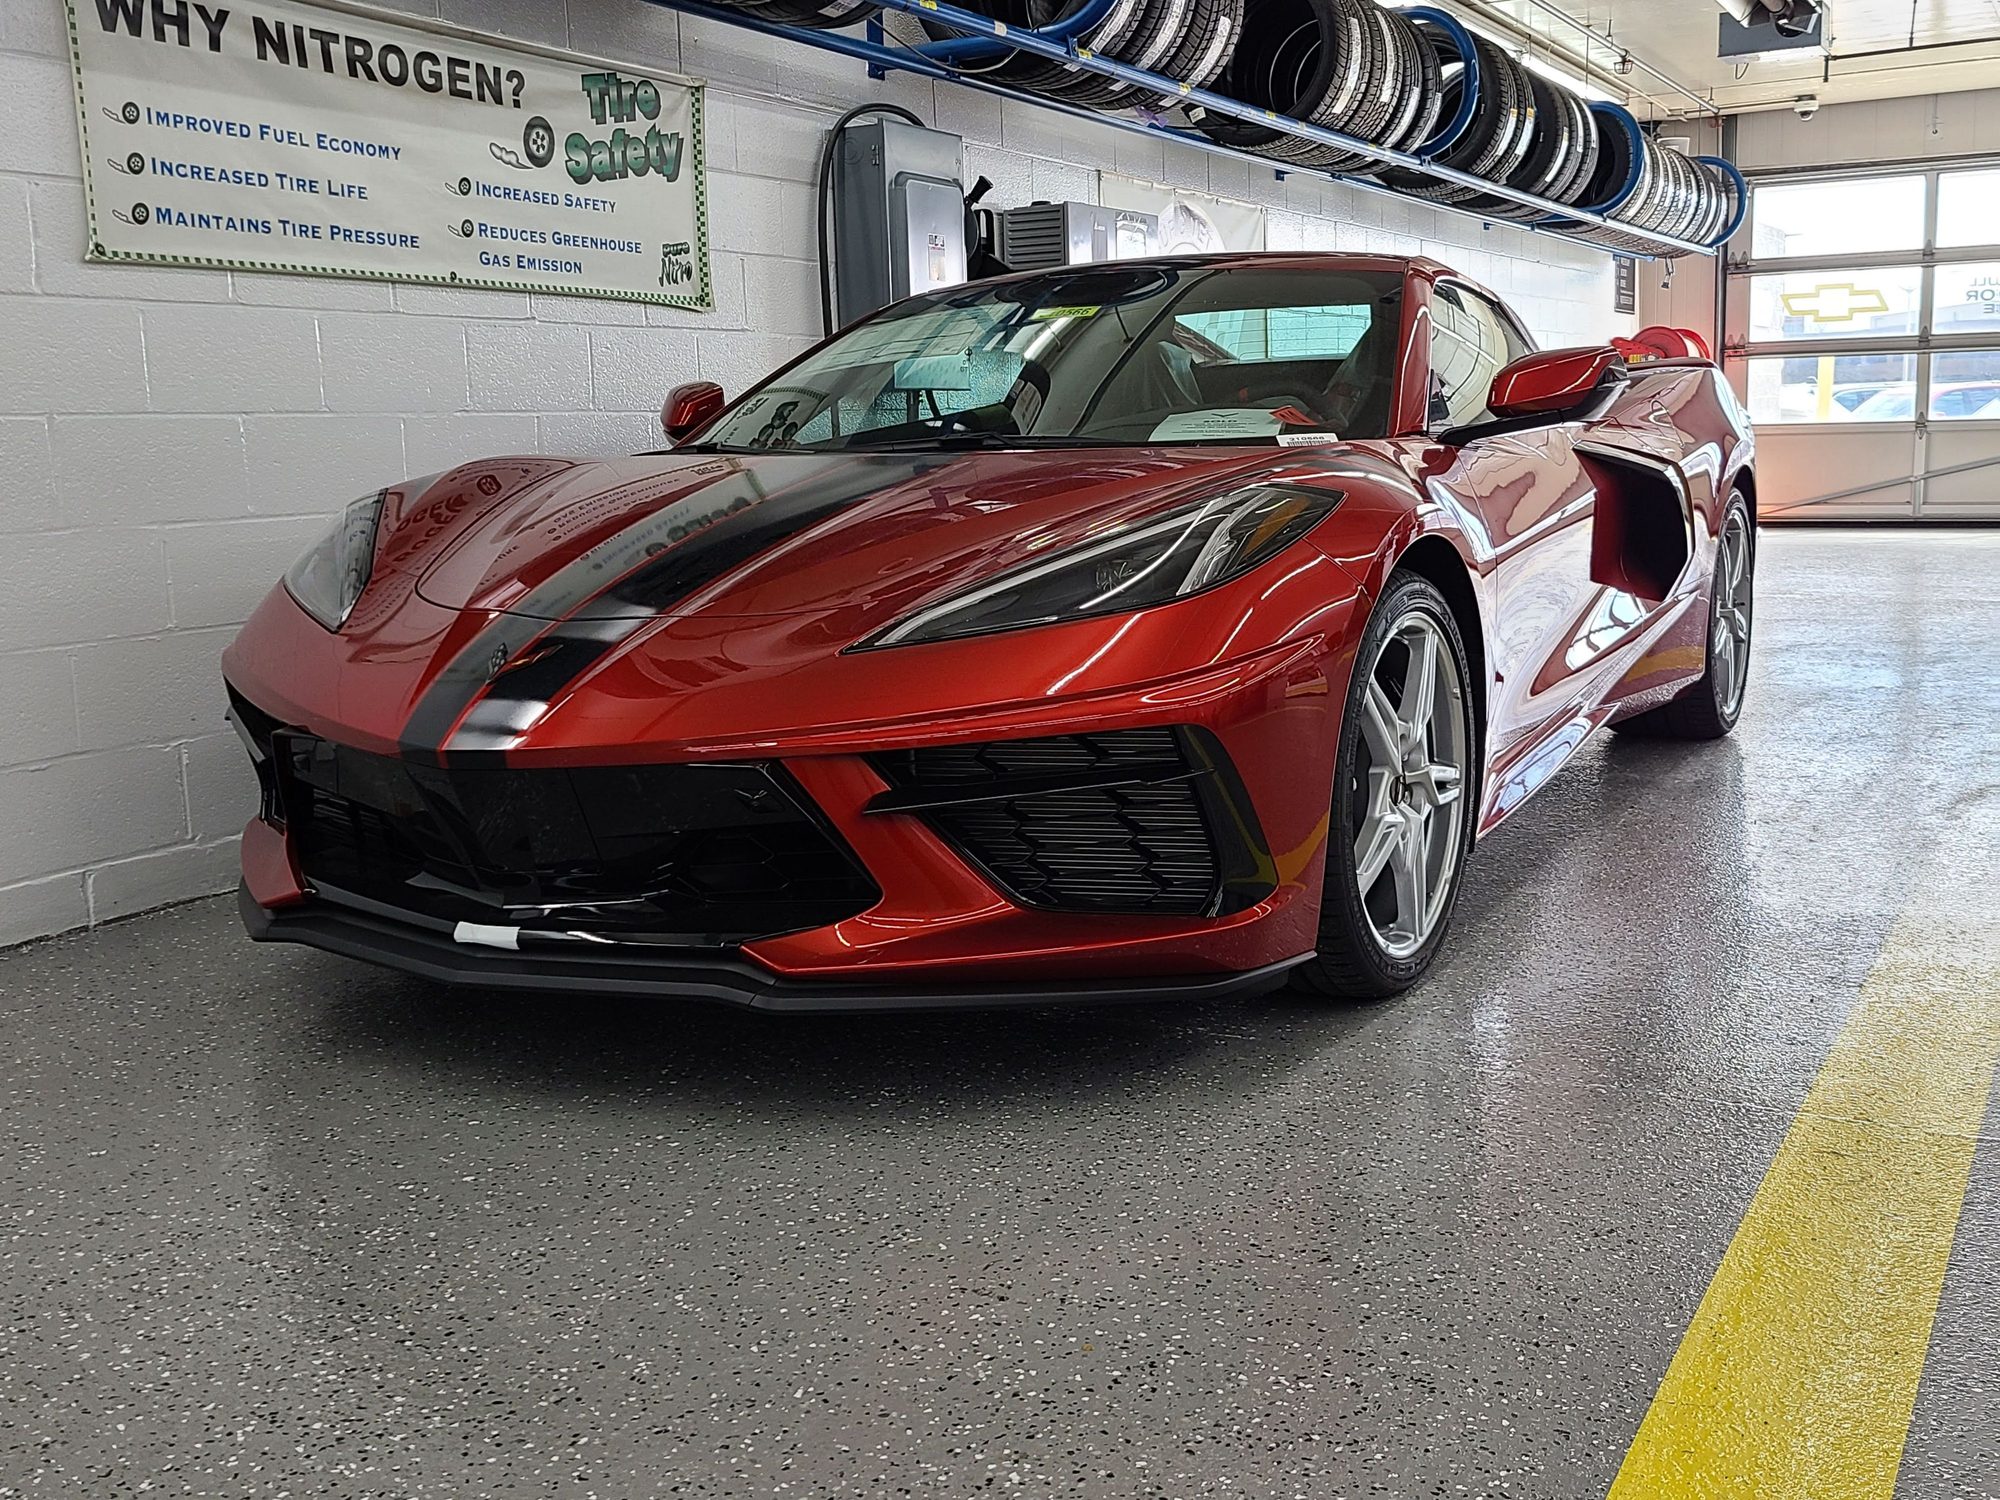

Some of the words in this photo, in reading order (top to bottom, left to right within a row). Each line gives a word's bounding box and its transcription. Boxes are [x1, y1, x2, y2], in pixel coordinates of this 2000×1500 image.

[97, 0, 230, 52] WHY
[252, 15, 525, 109] NITROGEN?
[581, 72, 662, 125] Tire
[146, 107, 251, 138] IMPROVED
[259, 123, 310, 148] FUEL
[316, 133, 401, 161] ECONOMY
[564, 123, 684, 185] Safety
[151, 157, 269, 188] INCREASED
[275, 172, 320, 194] TIRE
[327, 179, 369, 200] LIFE
[475, 181, 559, 206] INCREASED
[564, 194, 617, 213] SAFETY
[155, 207, 272, 234] MAINTAINS
[278, 219, 322, 240] TIRE
[330, 225, 420, 249] PRESSURE
[478, 222, 547, 244] REDUCES
[551, 231, 643, 254] GREENHOUSE
[479, 252, 511, 268] GAS
[516, 254, 583, 274] EMISSION
